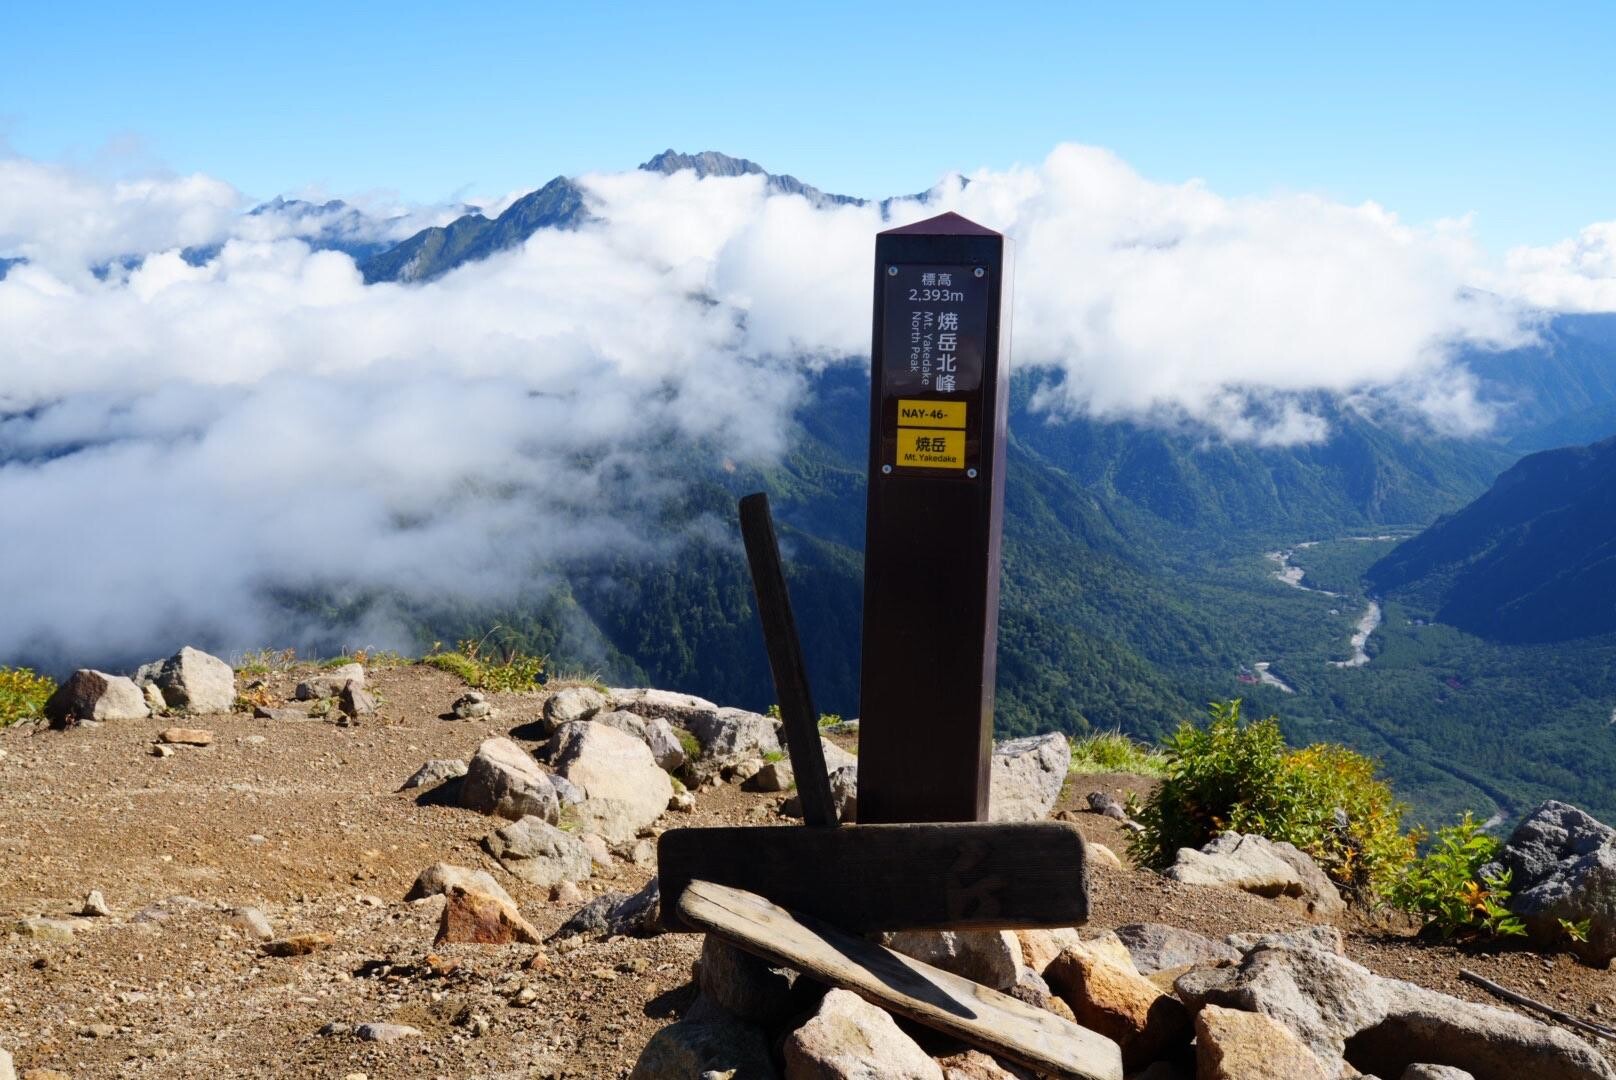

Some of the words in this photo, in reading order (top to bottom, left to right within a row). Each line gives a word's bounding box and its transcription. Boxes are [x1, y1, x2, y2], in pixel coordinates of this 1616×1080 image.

[922, 273, 952, 287] 標高
[908, 289, 964, 302] 2,393m
[911, 311, 922, 343] North
[923, 311, 934, 330] Mt.
[910, 347, 920, 373] Peak
[921, 333, 933, 385] Yakedake
[936, 312, 958, 392] 焼岳北峰
[915, 436, 946, 453] 焼岳
[904, 453, 918, 462] Mt.
[919, 453, 957, 463] Yakedake
